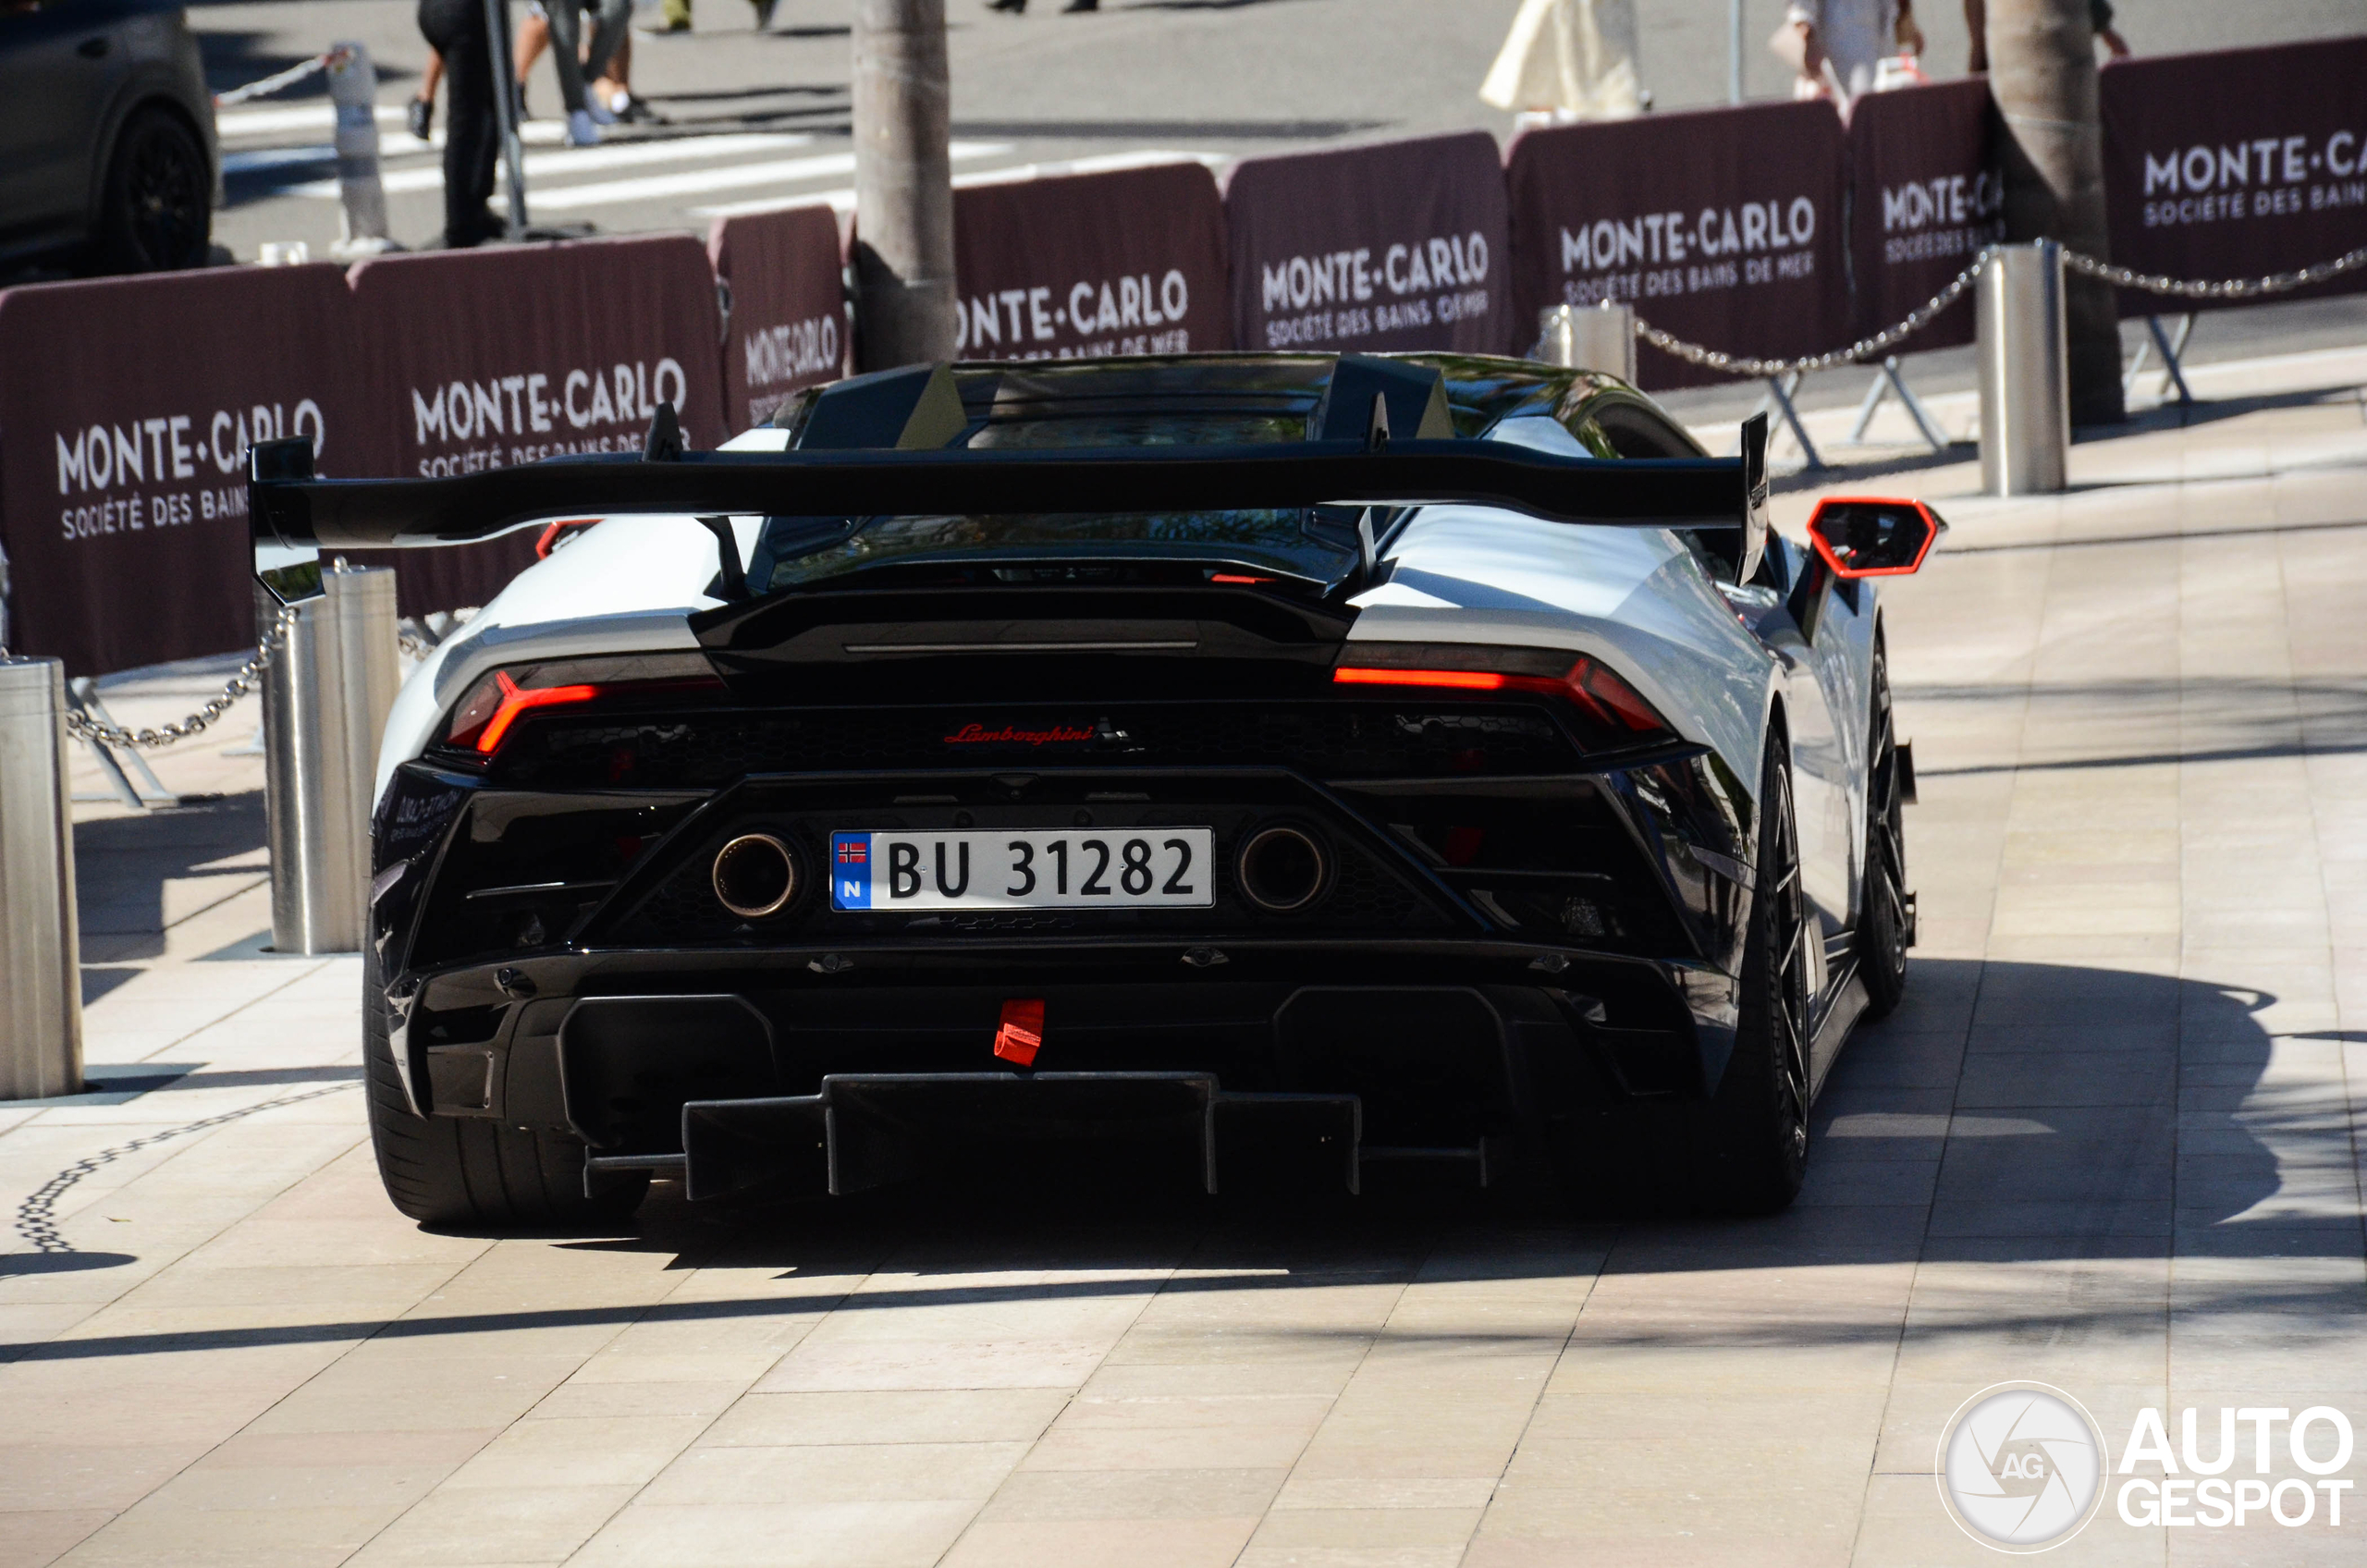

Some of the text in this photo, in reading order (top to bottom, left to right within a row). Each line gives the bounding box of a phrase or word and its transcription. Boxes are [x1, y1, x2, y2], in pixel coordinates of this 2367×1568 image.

[2143, 189, 2246, 227] SOCIÉTÉ
[2253, 186, 2303, 217] DES
[1646, 268, 1684, 297] DES
[1337, 307, 1372, 338] DES
[61, 484, 249, 541] SOCIÉTÉ DES BAIN
[944, 723, 1095, 746] Lamborghini
[889, 838, 1194, 899] BU 31282
[843, 880, 861, 899] N
